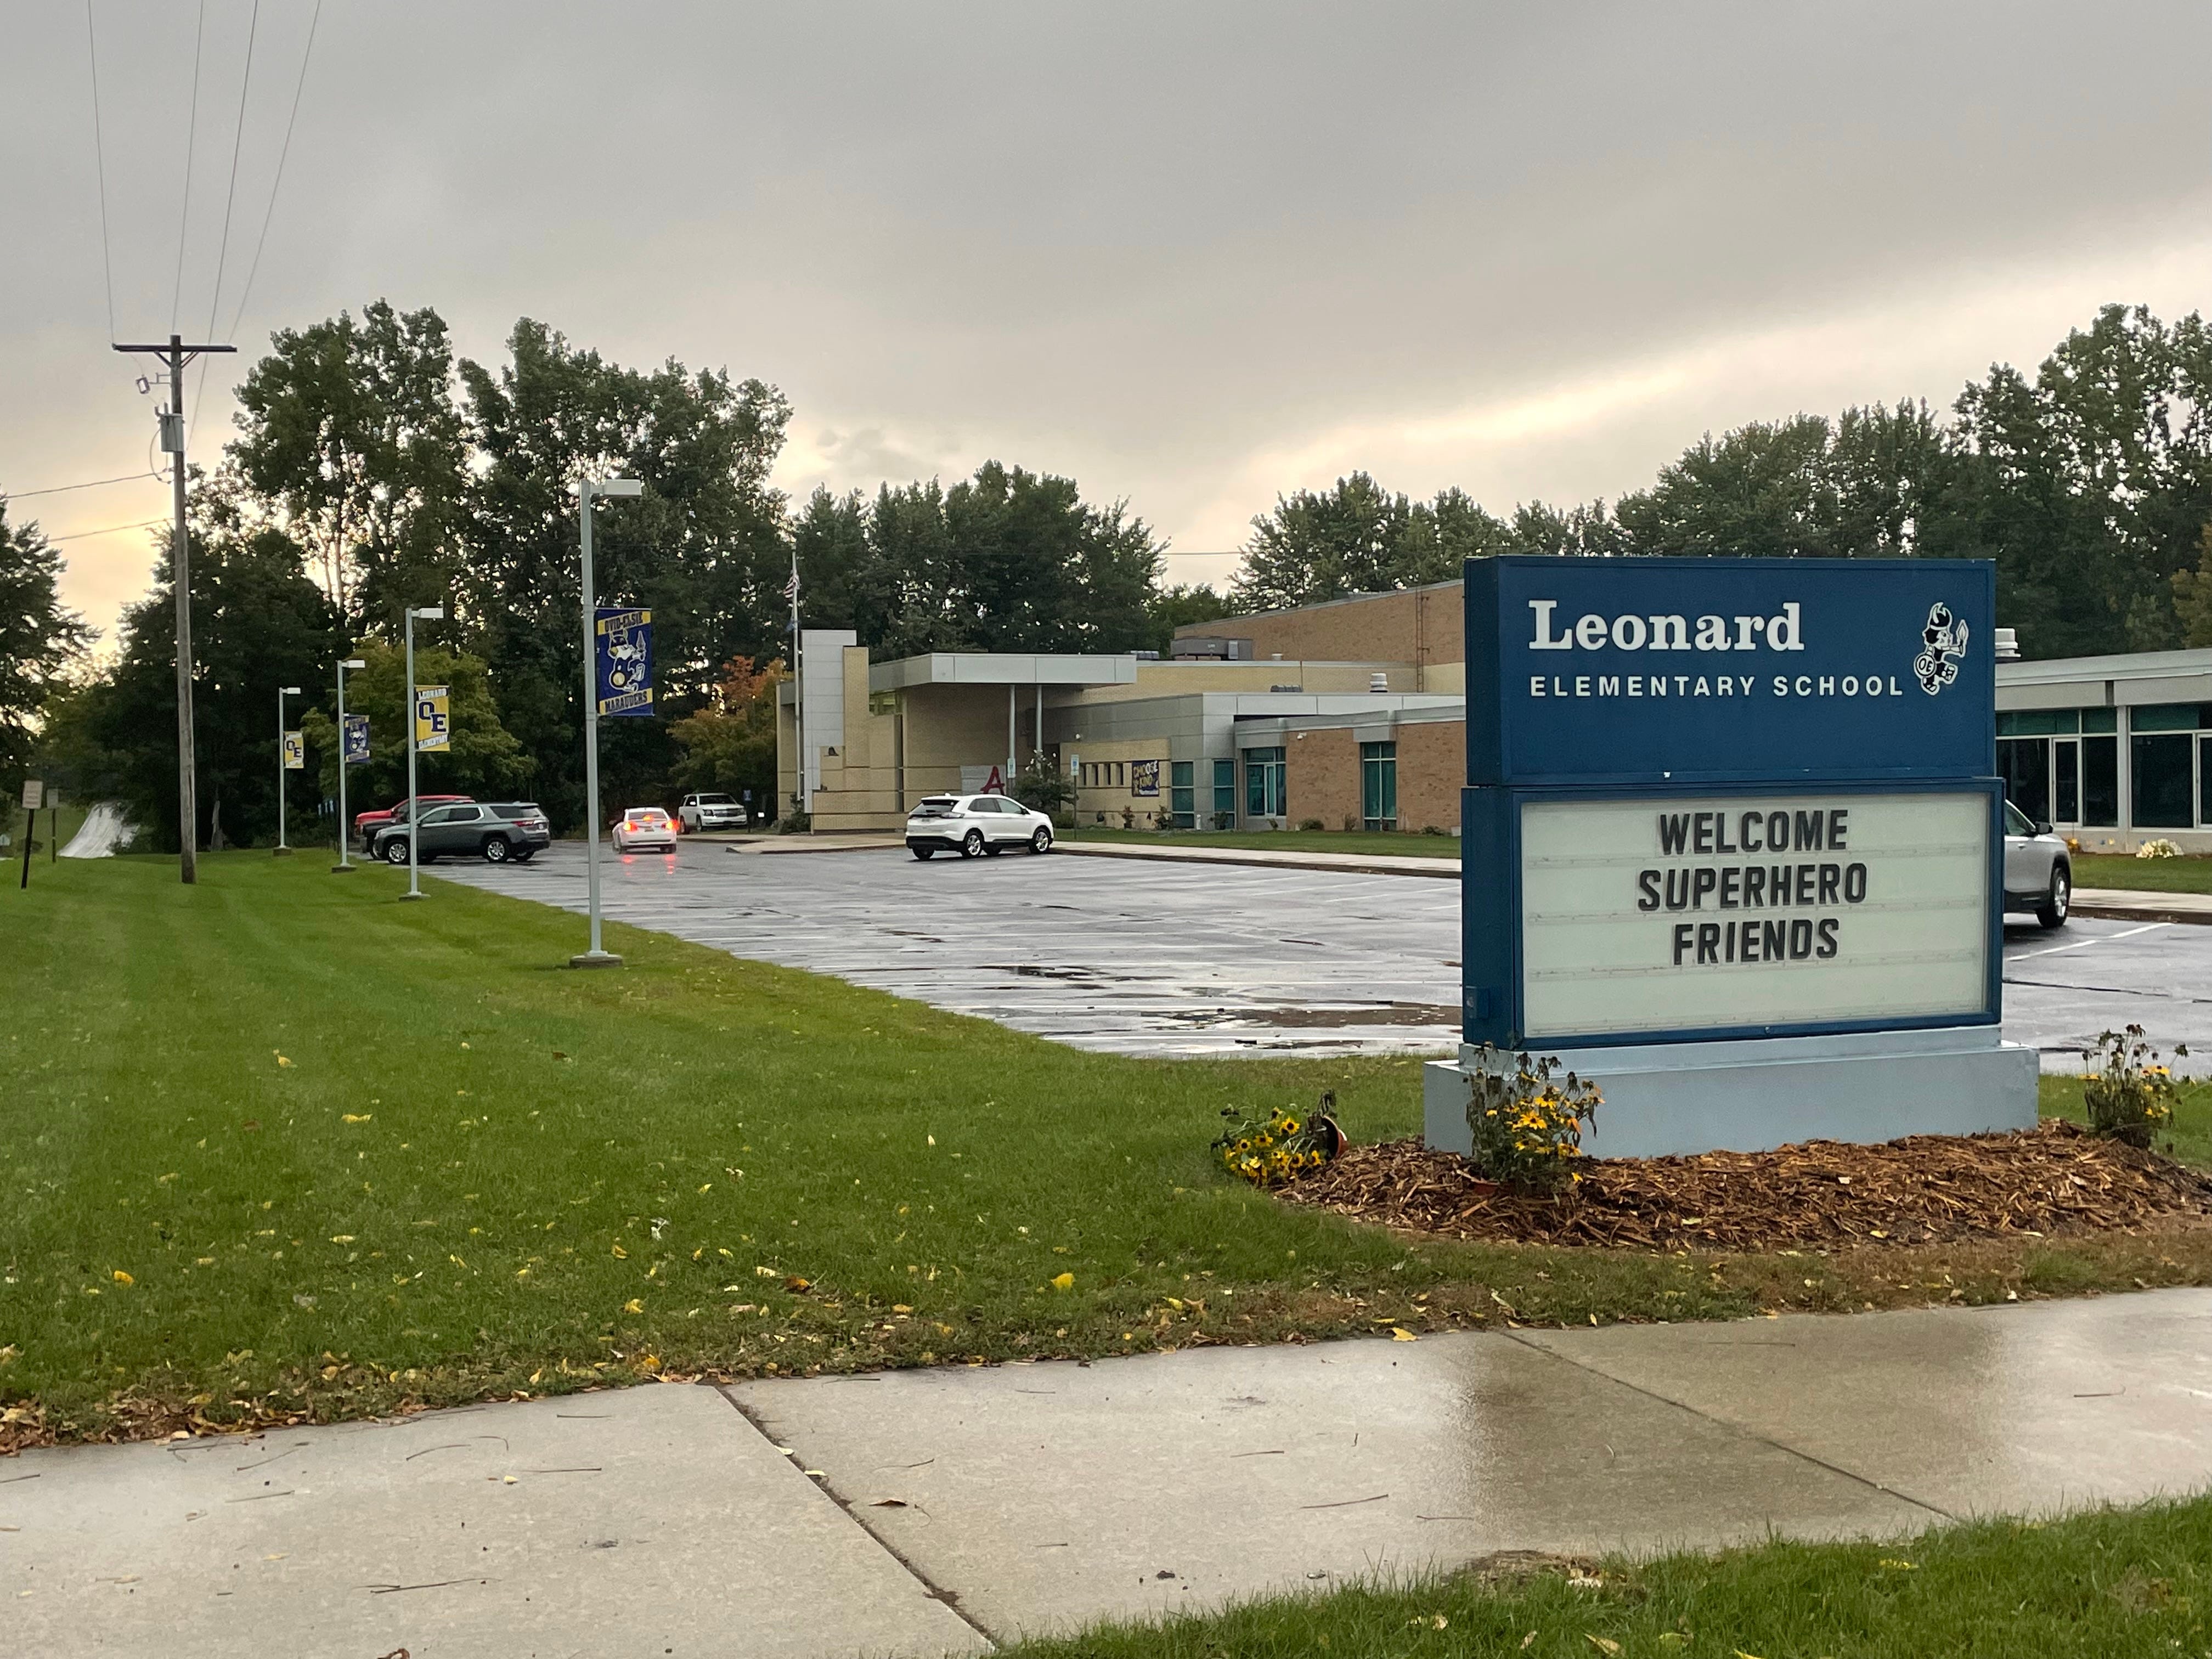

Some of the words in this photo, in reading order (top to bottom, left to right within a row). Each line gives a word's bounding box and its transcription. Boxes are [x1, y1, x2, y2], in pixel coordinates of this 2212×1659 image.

[1528, 600, 1804, 651] Leonard
[605, 691, 647, 713] MARAUDERS
[1531, 676, 1755, 696] ELEMENTARY
[1773, 676, 1903, 696] SCHOOL
[1660, 809, 1848, 855] WELCOME
[1638, 863, 1867, 911] SUPERHERO
[1674, 918, 1839, 965] FRIENDS
